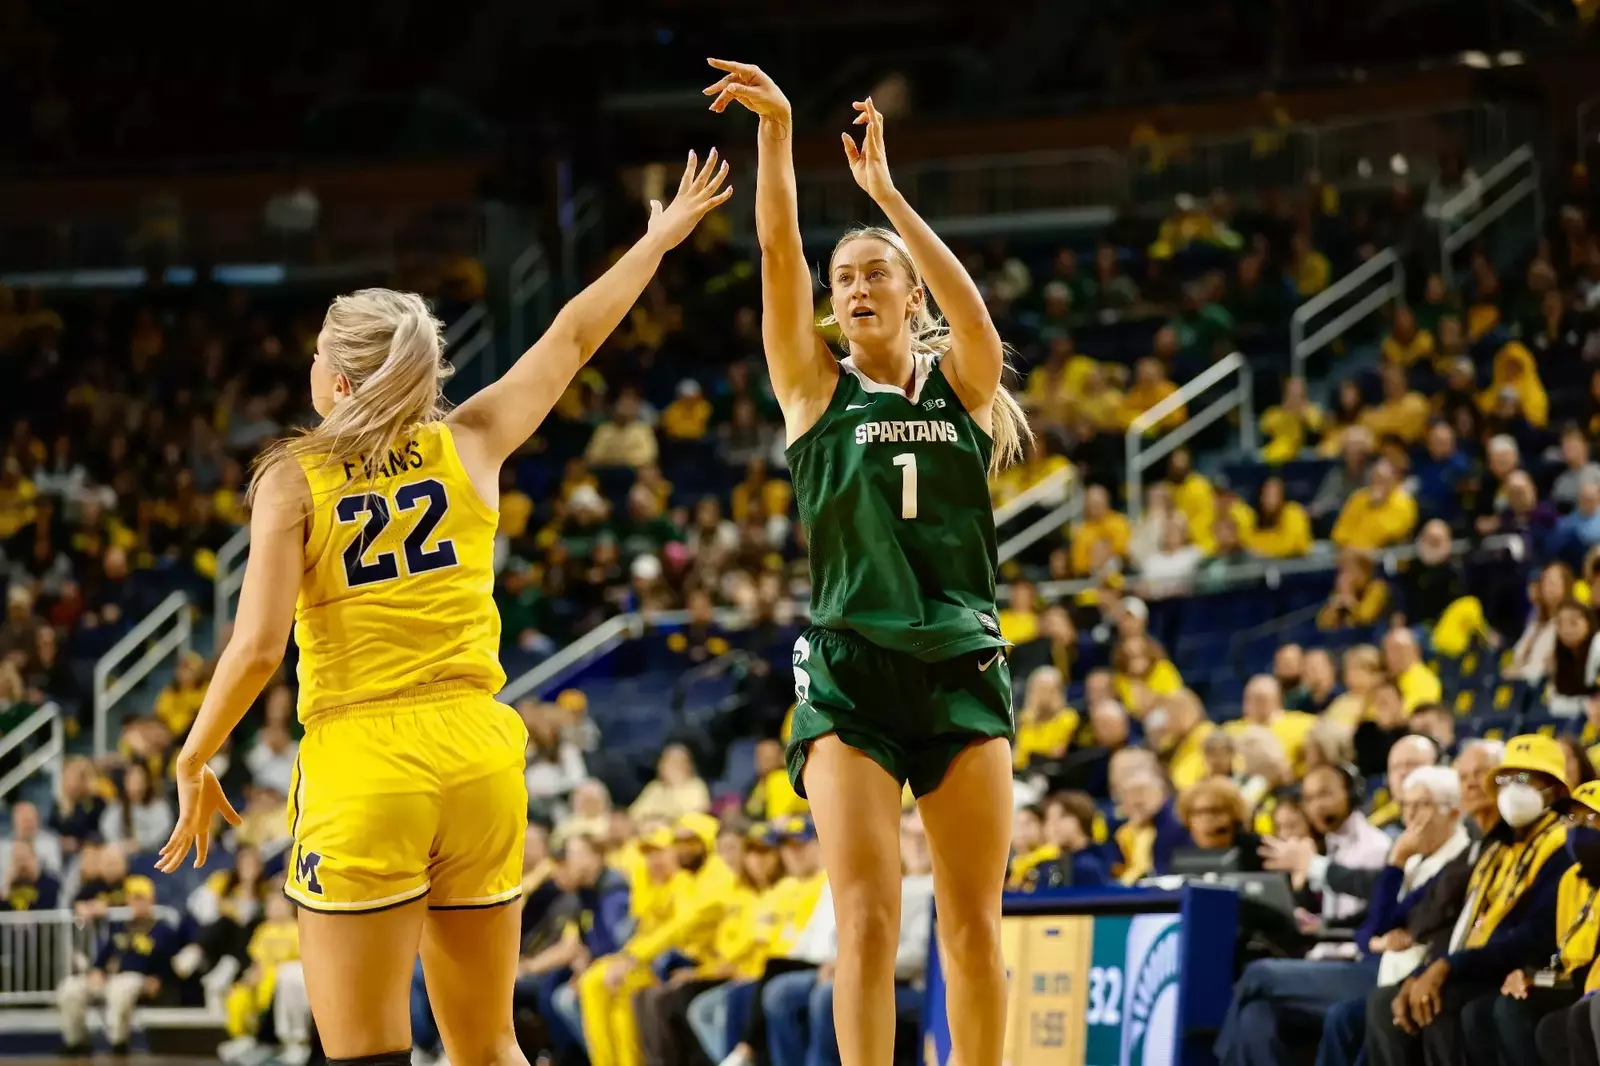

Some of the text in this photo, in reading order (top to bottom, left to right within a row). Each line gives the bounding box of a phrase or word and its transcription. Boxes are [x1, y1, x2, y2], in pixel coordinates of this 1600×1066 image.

[855, 420, 959, 445] SPARTANS
[892, 452, 918, 519] 1
[335, 478, 460, 589] 22
[294, 843, 324, 895] M
[1086, 966, 1123, 1026] 32
